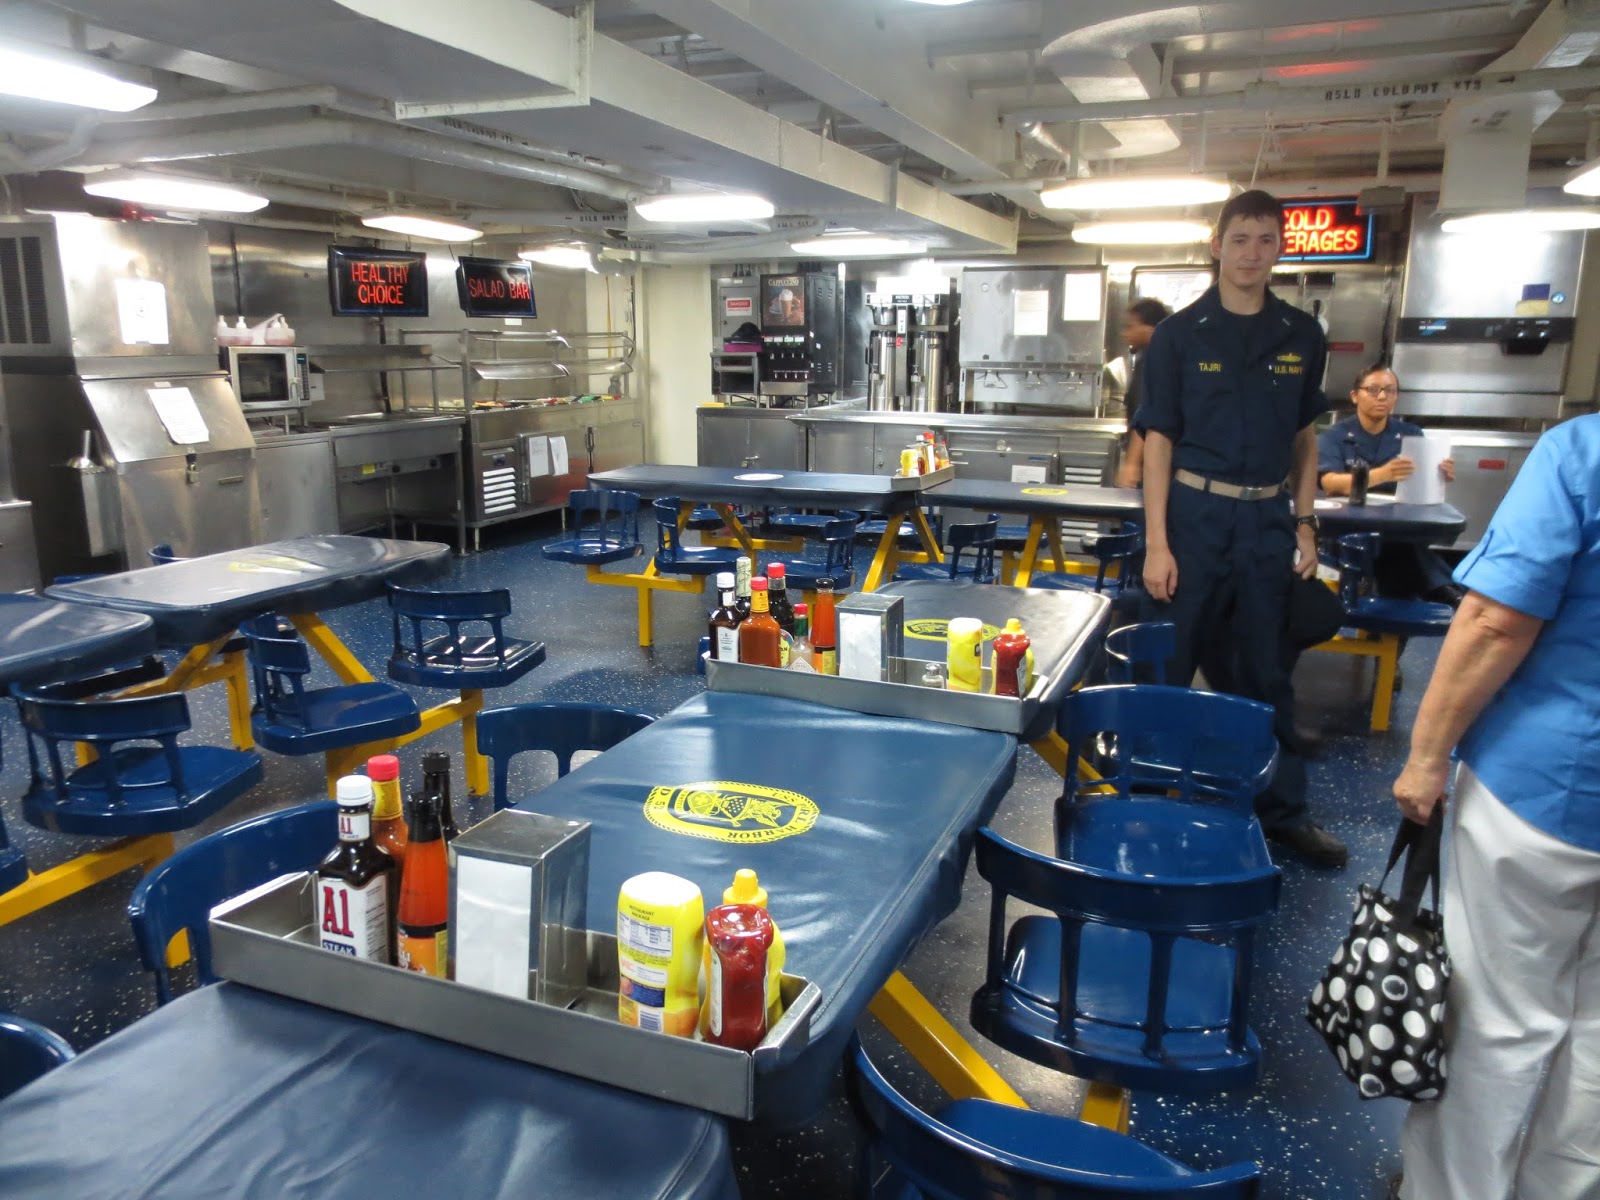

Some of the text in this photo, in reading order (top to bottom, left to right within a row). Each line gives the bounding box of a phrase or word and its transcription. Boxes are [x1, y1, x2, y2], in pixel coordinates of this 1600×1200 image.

[352, 263, 409, 284] HEALTHY
[358, 285, 404, 305] CHOICE
[469, 278, 530, 300] SALAD BAR
[1199, 363, 1221, 372] TAJIRI
[1274, 366, 1303, 374] U.S. NAVY
[727, 825, 798, 840] HARBOR
[323, 886, 354, 938] A1
[323, 941, 353, 956] STEAK
